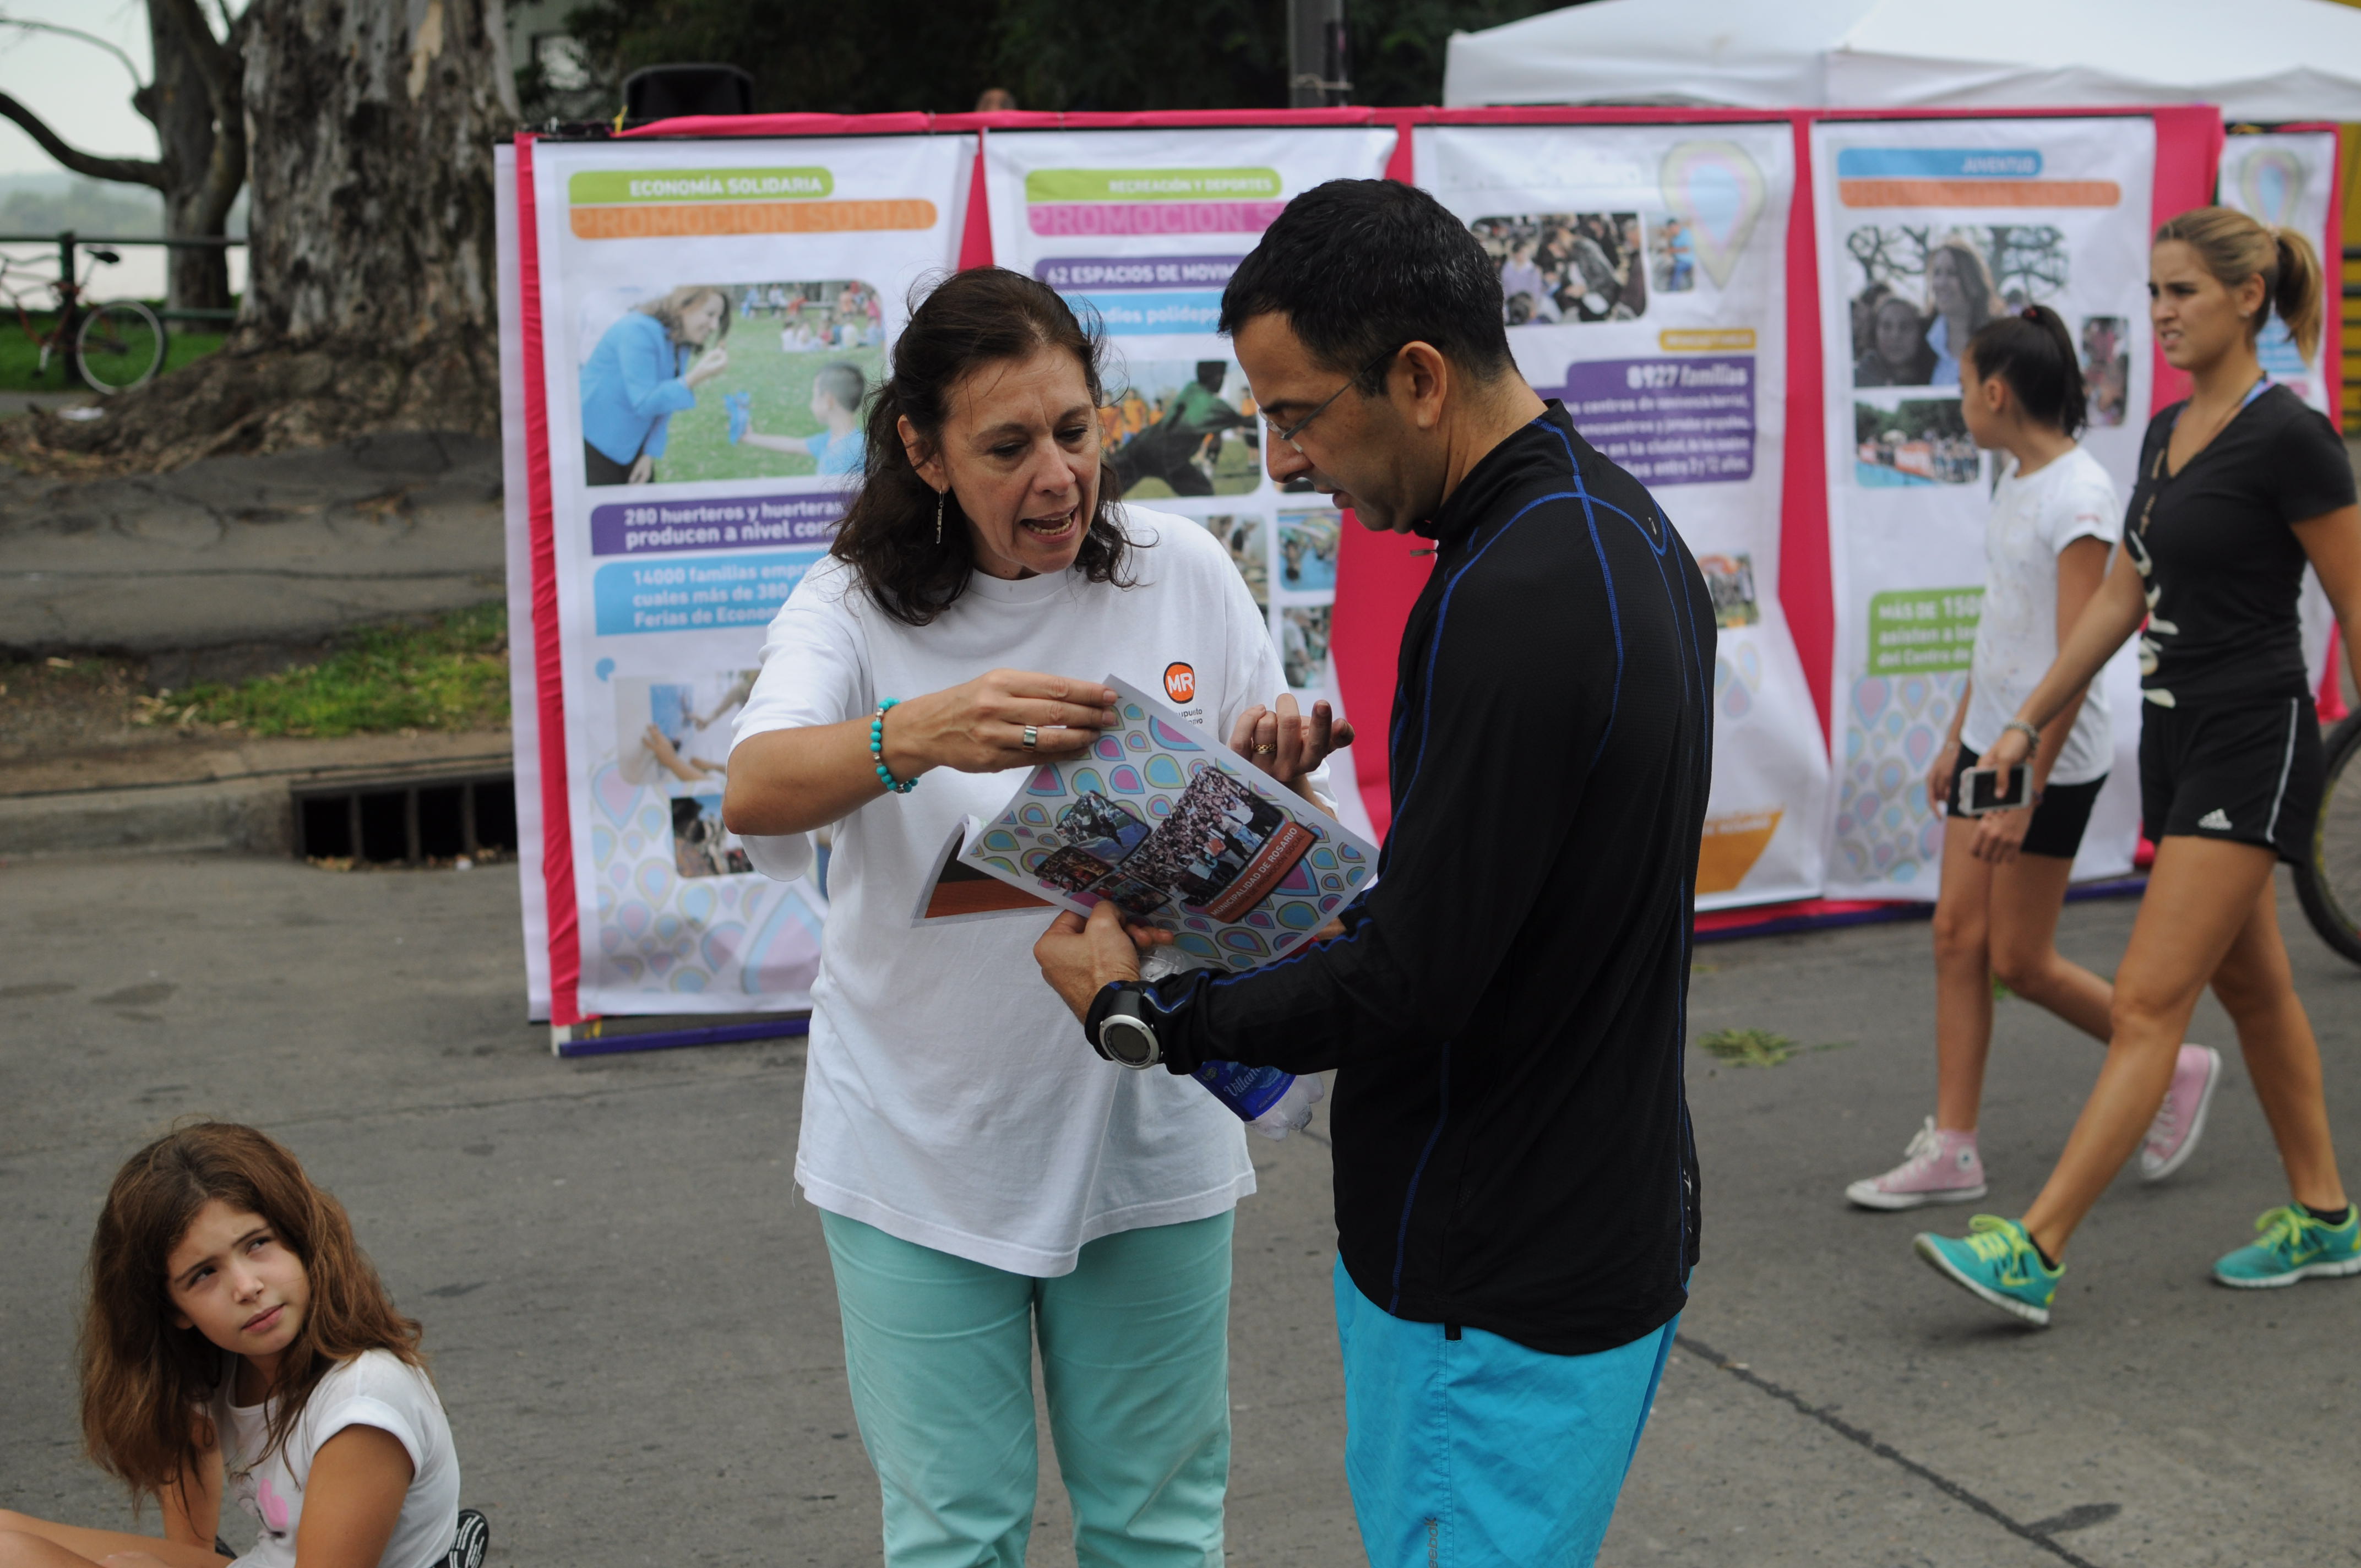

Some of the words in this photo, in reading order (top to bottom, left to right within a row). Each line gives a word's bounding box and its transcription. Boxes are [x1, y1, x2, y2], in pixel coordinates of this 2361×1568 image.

[629, 175, 724, 197] ECONOMÍA
[727, 176, 823, 195] SOLIDARIA
[1108, 177, 1192, 193] RECREACIÓN
[1194, 179, 1203, 192] Y
[1205, 177, 1275, 192] DEPORTES
[1047, 267, 1069, 284] 62
[1071, 265, 1155, 284] ESPACIOS
[1157, 264, 1179, 282] DE
[624, 508, 658, 526] 280
[660, 505, 746, 524] huerteros
[747, 506, 759, 523] y
[625, 525, 721, 552] producen
[723, 526, 738, 542] a
[741, 520, 791, 541] nivel
[633, 567, 686, 586] 14000
[689, 563, 757, 584] familias
[633, 589, 688, 607] cuales
[693, 587, 728, 604] más
[732, 585, 753, 602] de
[757, 582, 788, 600] 380
[634, 609, 688, 628] Ferias
[691, 607, 712, 624] de
[1879, 599, 1913, 621] MÁS
[1916, 602, 1938, 620] DE
[1167, 672, 1194, 694] MR
[1287, 834, 1305, 856] SOCIAL
[1211, 872, 1261, 916] MUNICIPALIDAD
[1258, 861, 1271, 873] DE
[1267, 827, 1297, 863] ROSARIO
